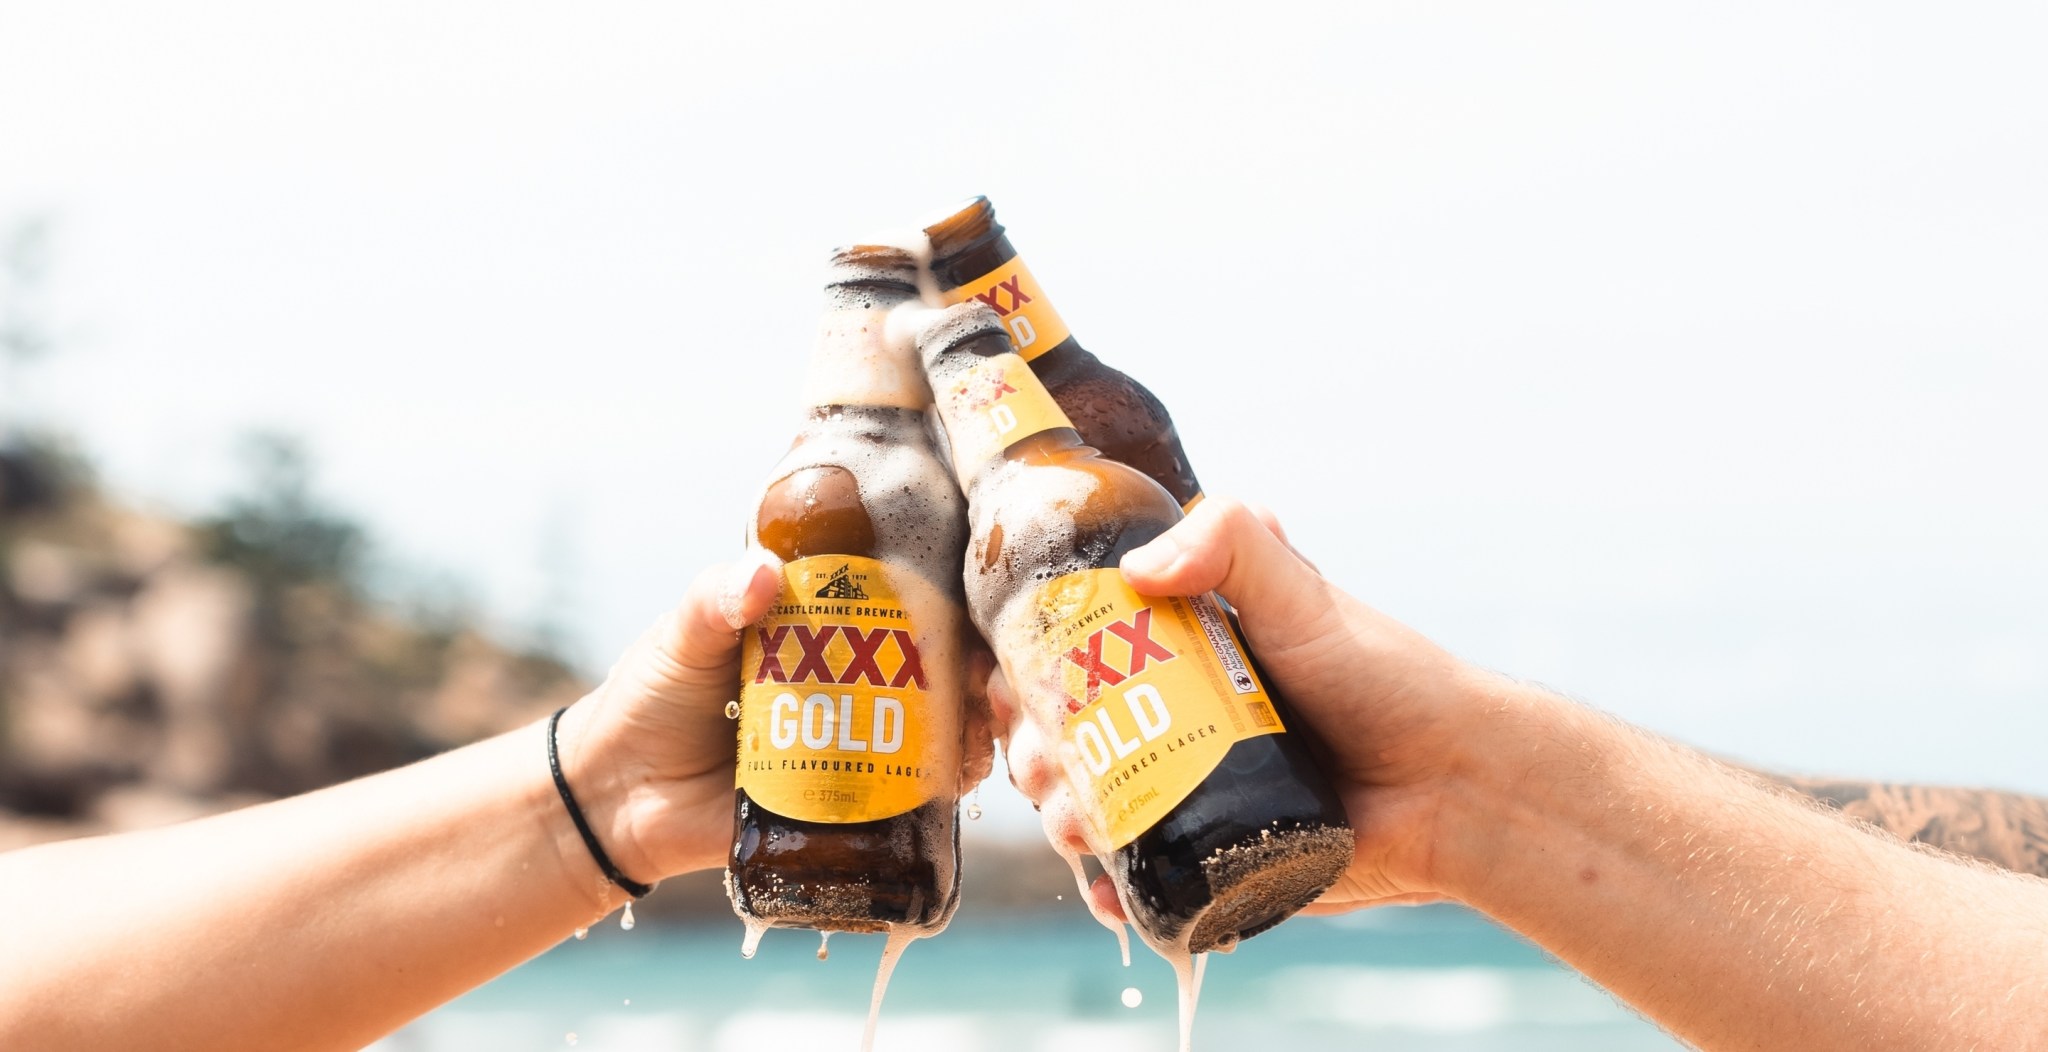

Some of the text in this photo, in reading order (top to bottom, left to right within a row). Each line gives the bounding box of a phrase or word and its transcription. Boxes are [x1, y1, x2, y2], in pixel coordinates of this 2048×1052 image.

[777, 605, 851, 616] CASTLEMAINE
[1201, 620, 1233, 672] PREGNANCY
[1221, 643, 1240, 670] Alcohol
[769, 693, 905, 754] GOLD
[1167, 724, 1217, 752] LAGER
[782, 759, 875, 773] FLAVOURED
[886, 764, 929, 778] LAGE
[818, 789, 858, 803] 375mL
